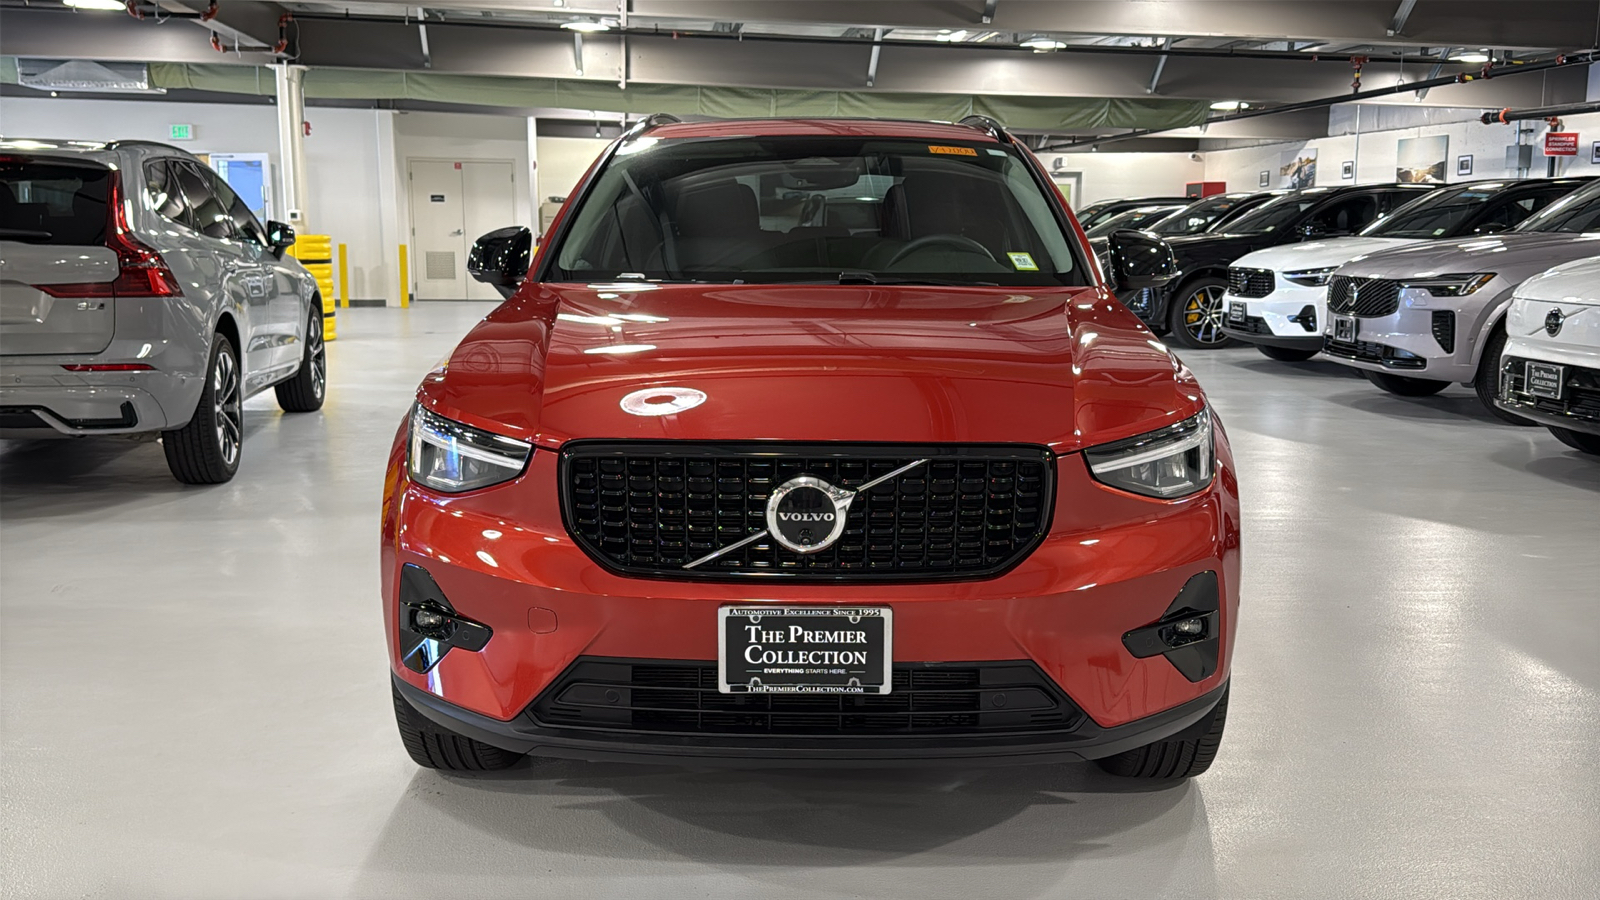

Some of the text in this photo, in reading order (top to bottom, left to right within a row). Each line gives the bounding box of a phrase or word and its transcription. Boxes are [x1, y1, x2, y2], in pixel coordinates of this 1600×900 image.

[172, 125, 189, 138] EXIT
[778, 512, 835, 522] VOLVO
[732, 608, 782, 616] AUTOMOTIVE
[784, 608, 831, 616] EXCELLENCE
[744, 625, 868, 644] THE PREMIER
[744, 644, 868, 665] COLLECTION
